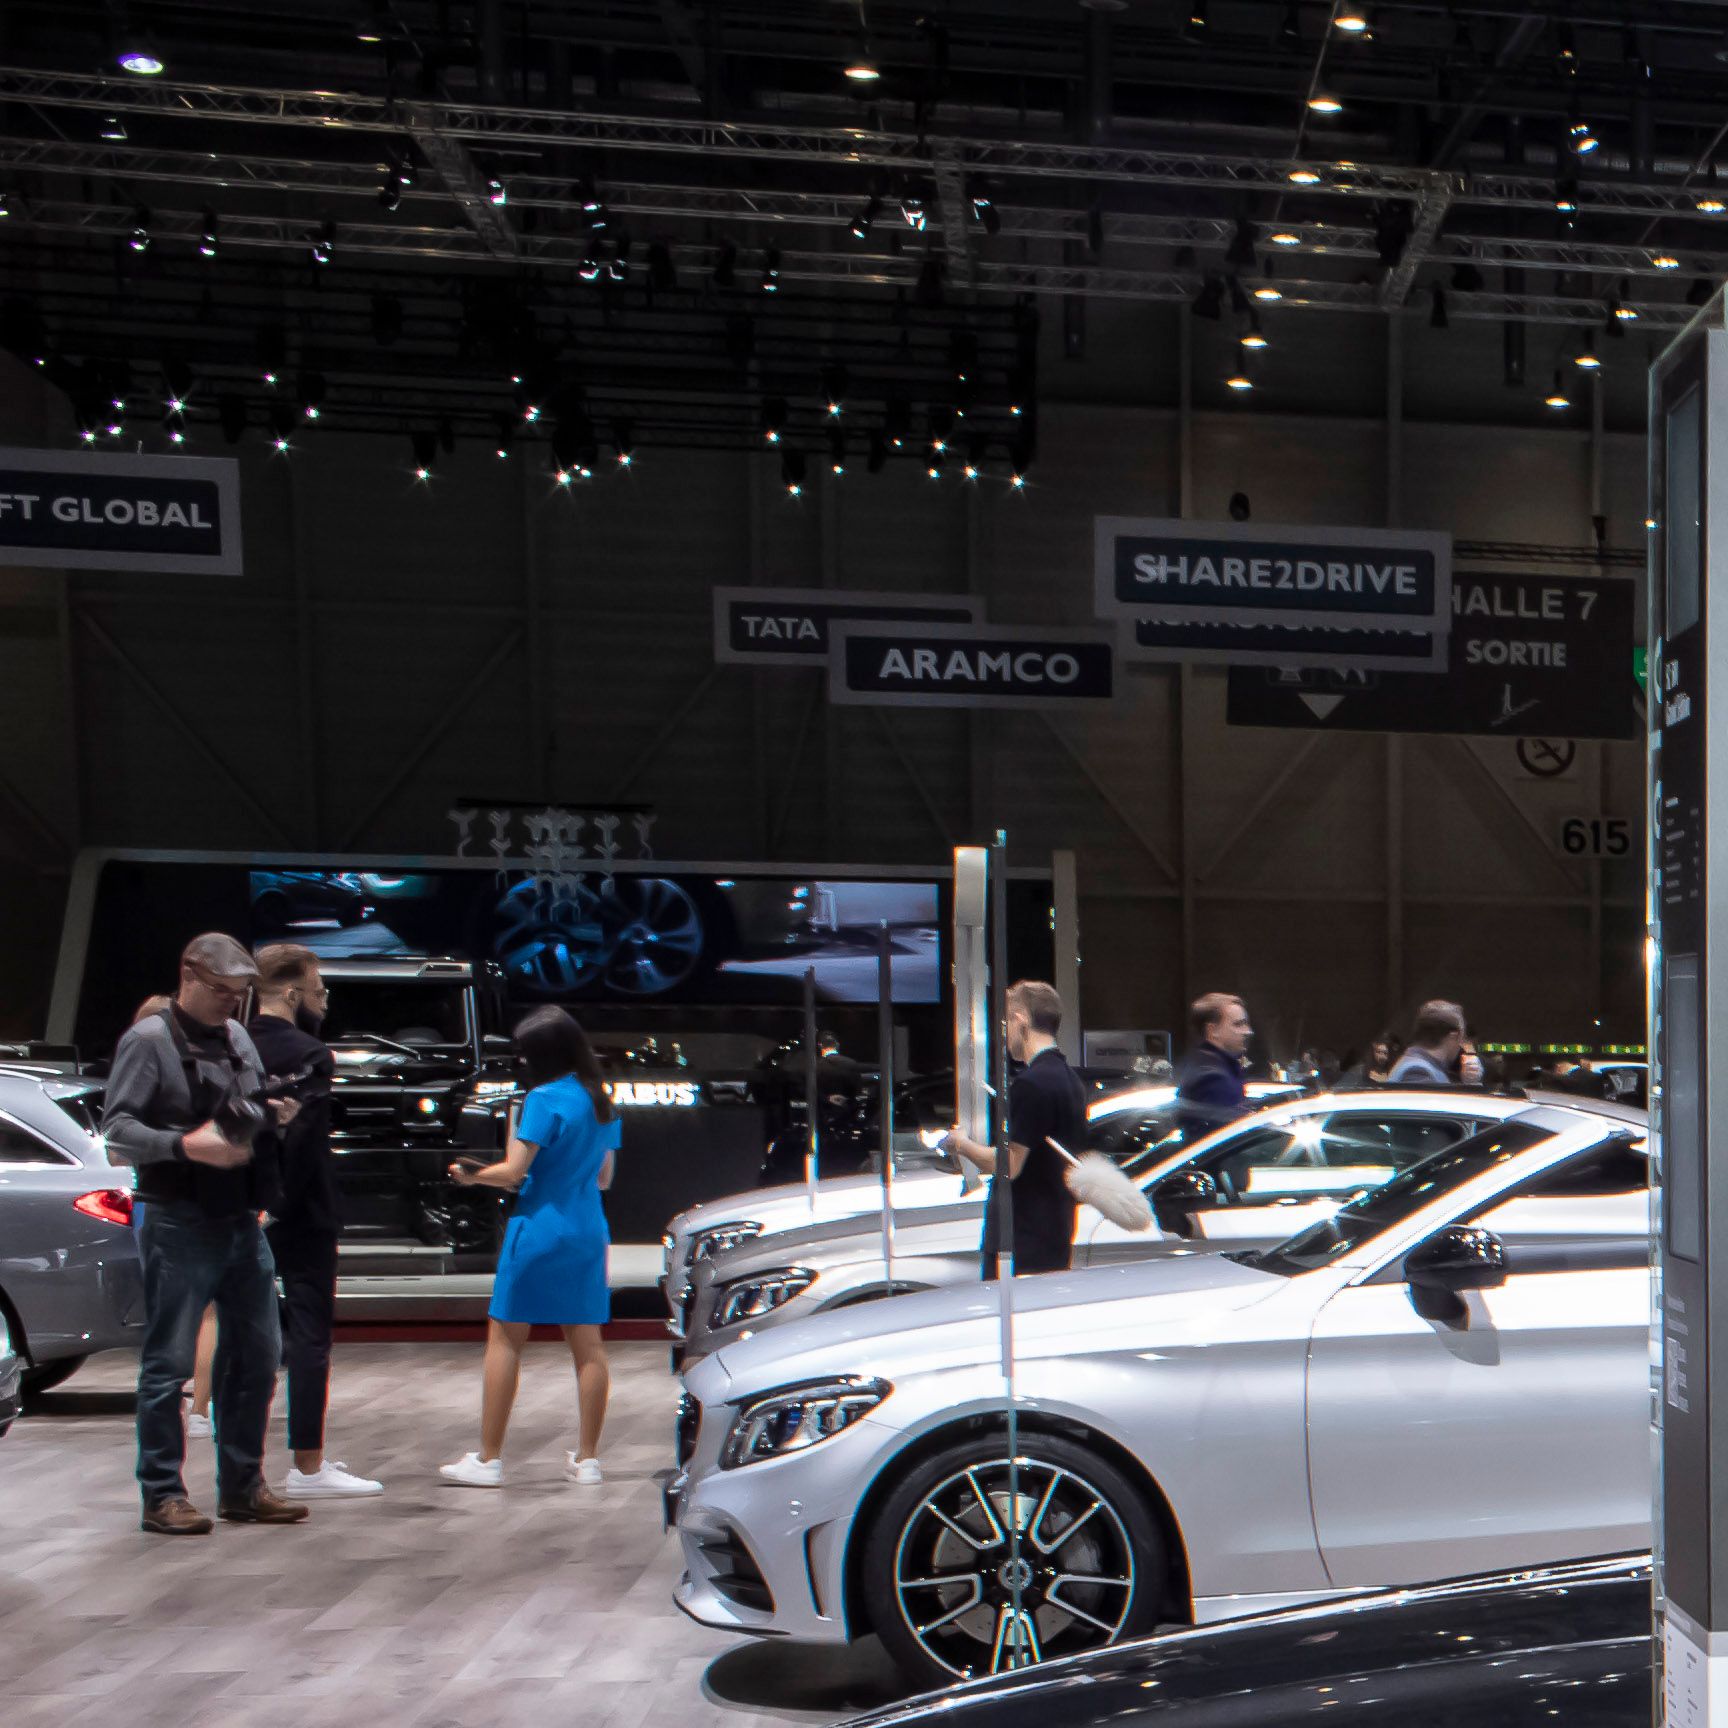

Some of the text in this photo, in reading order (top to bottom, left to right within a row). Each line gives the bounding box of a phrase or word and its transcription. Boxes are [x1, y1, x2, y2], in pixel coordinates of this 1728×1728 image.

[51, 496, 212, 528] GLOBAL
[1133, 553, 1418, 595] SHARE2DRIVE
[1576, 590, 1598, 621] 7
[740, 616, 820, 640] TATA
[879, 647, 1081, 685] ARAMCO
[1465, 639, 1567, 667] SORTIE
[1562, 819, 1631, 855] 615
[602, 1081, 700, 1106] ABUS
